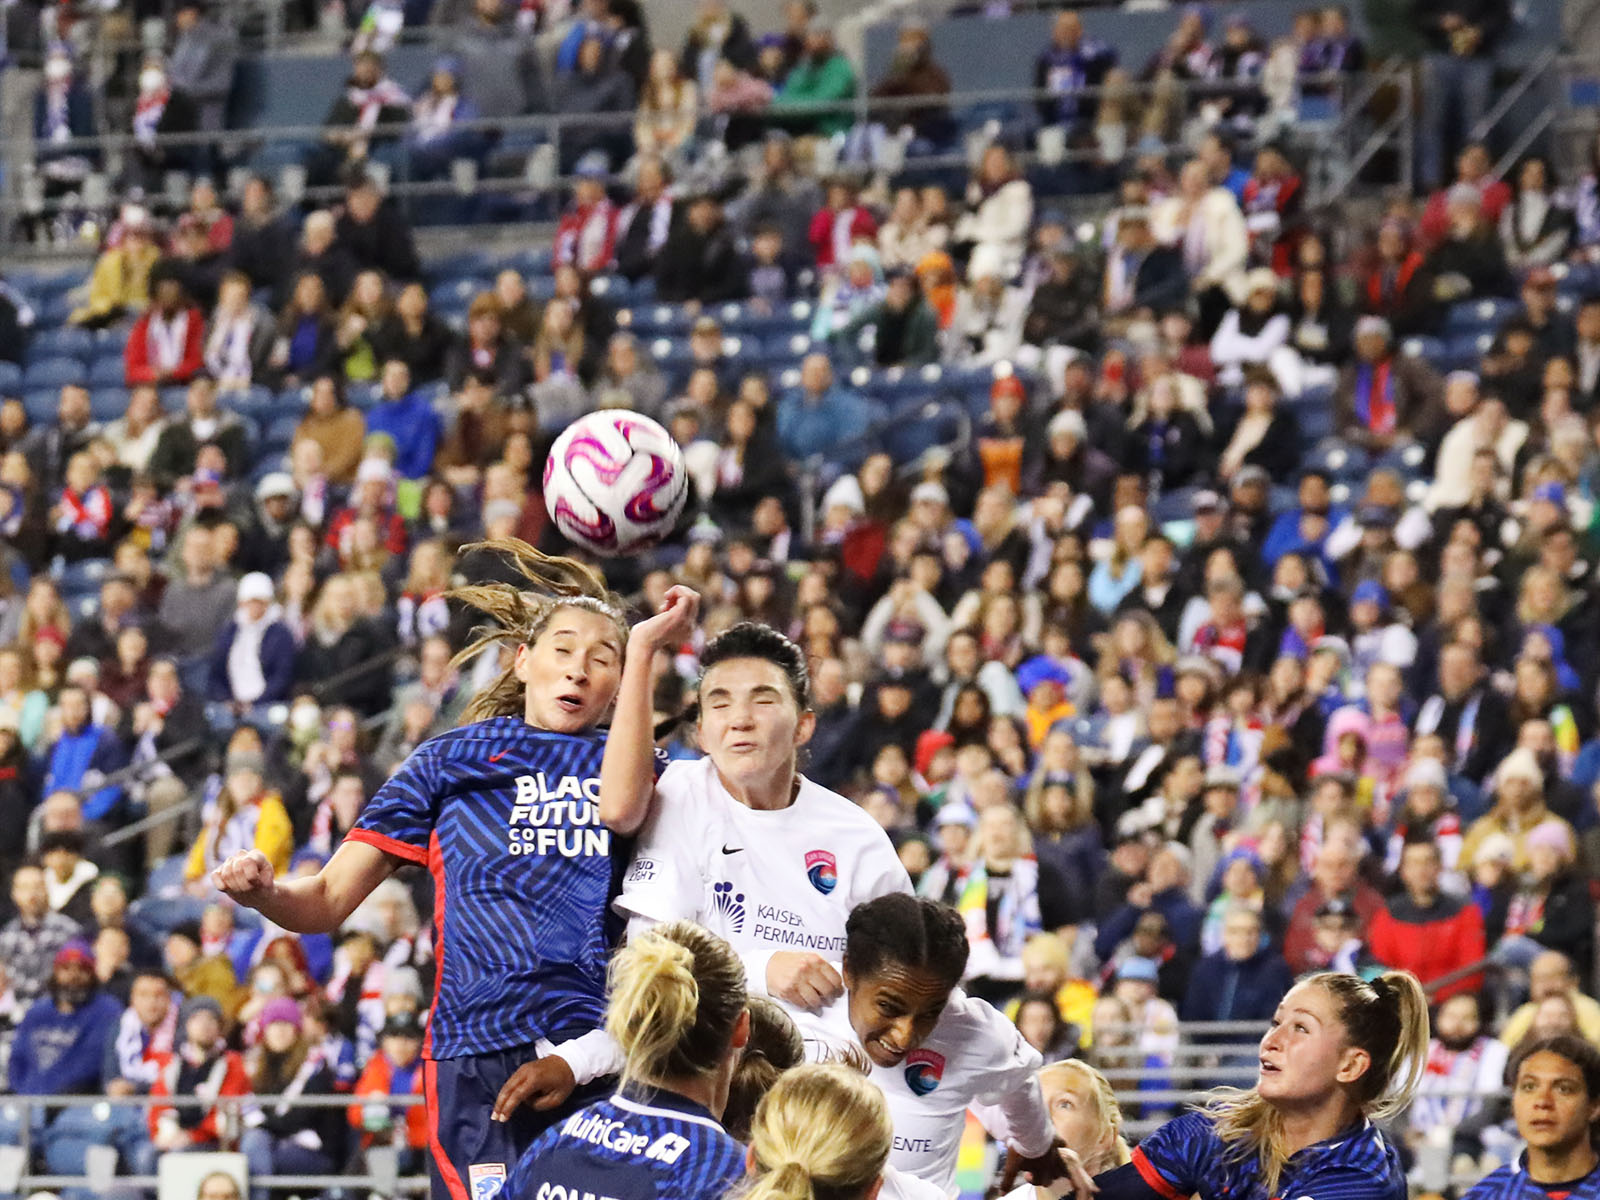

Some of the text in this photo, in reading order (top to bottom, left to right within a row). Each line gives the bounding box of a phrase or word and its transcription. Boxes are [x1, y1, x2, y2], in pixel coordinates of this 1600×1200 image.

[514, 771, 602, 805] BLAC
[509, 800, 601, 827] FUTU
[757, 904, 806, 928] KAISER
[753, 923, 848, 952] PERMANENTE
